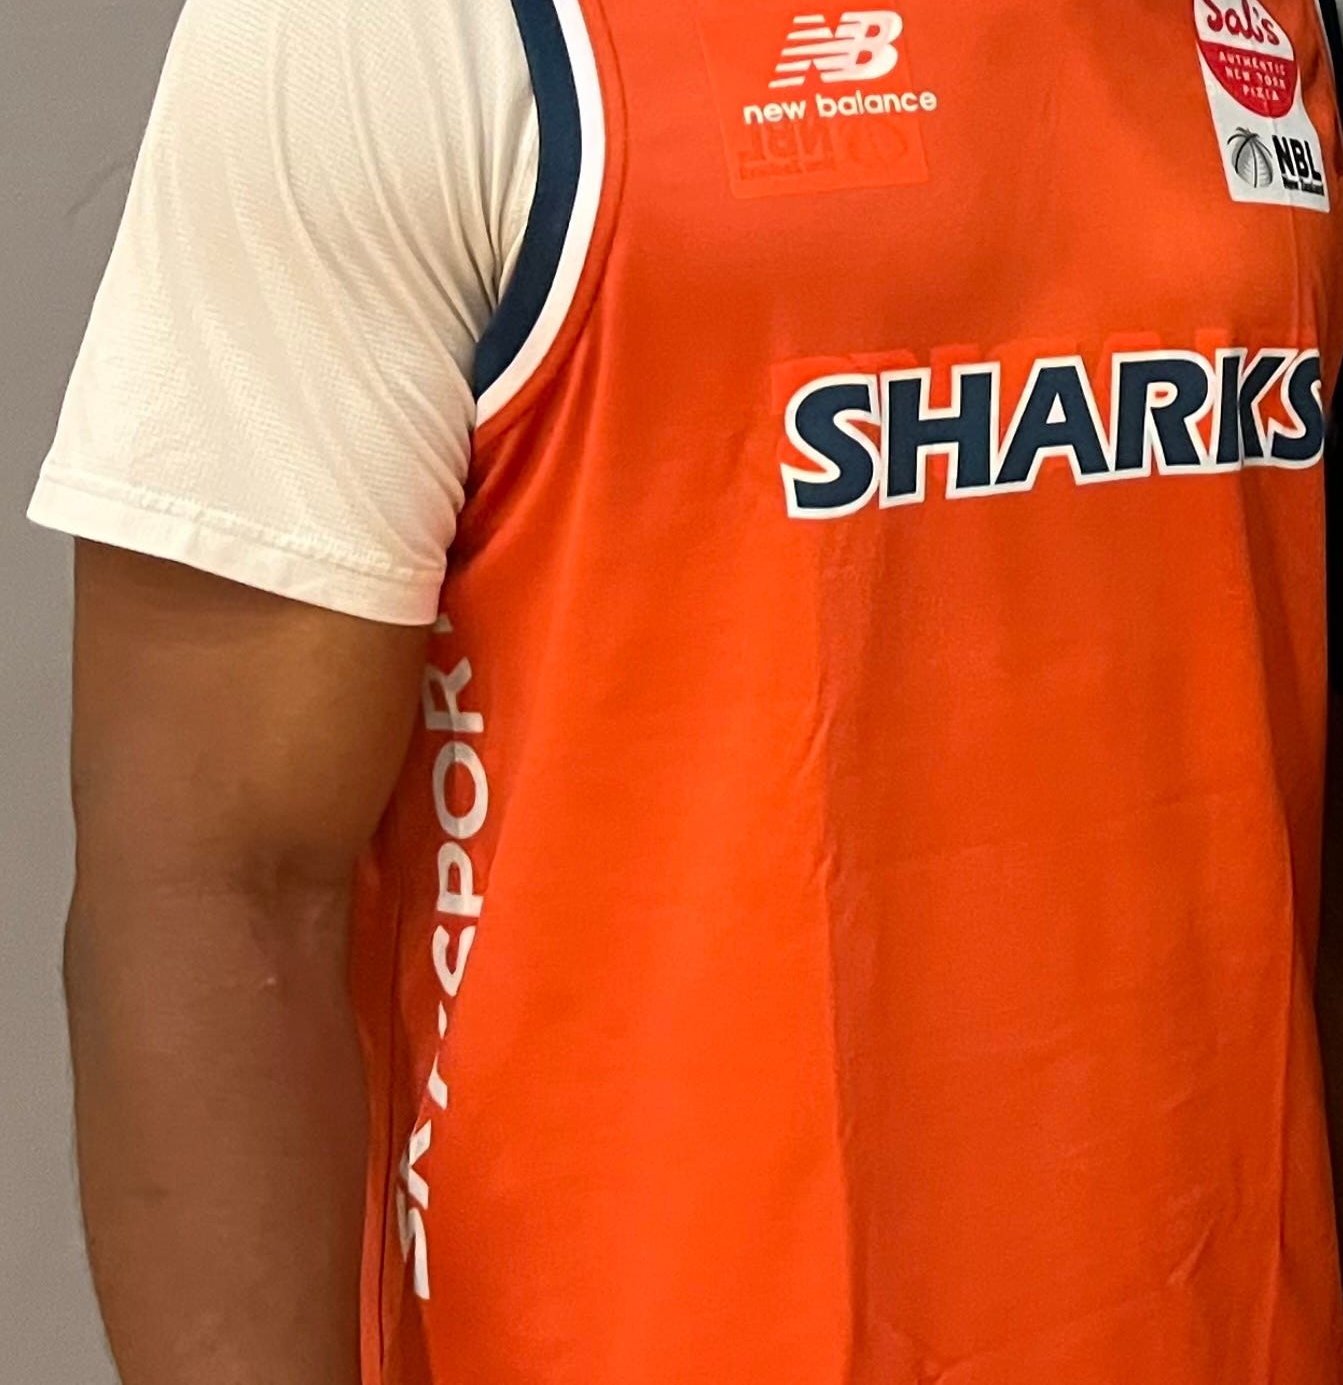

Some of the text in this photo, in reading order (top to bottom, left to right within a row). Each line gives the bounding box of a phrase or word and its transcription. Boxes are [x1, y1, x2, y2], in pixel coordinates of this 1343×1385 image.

[743, 89, 938, 125] new balance
[1272, 134, 1322, 181] NBL
[780, 348, 1324, 519] SHARKS
